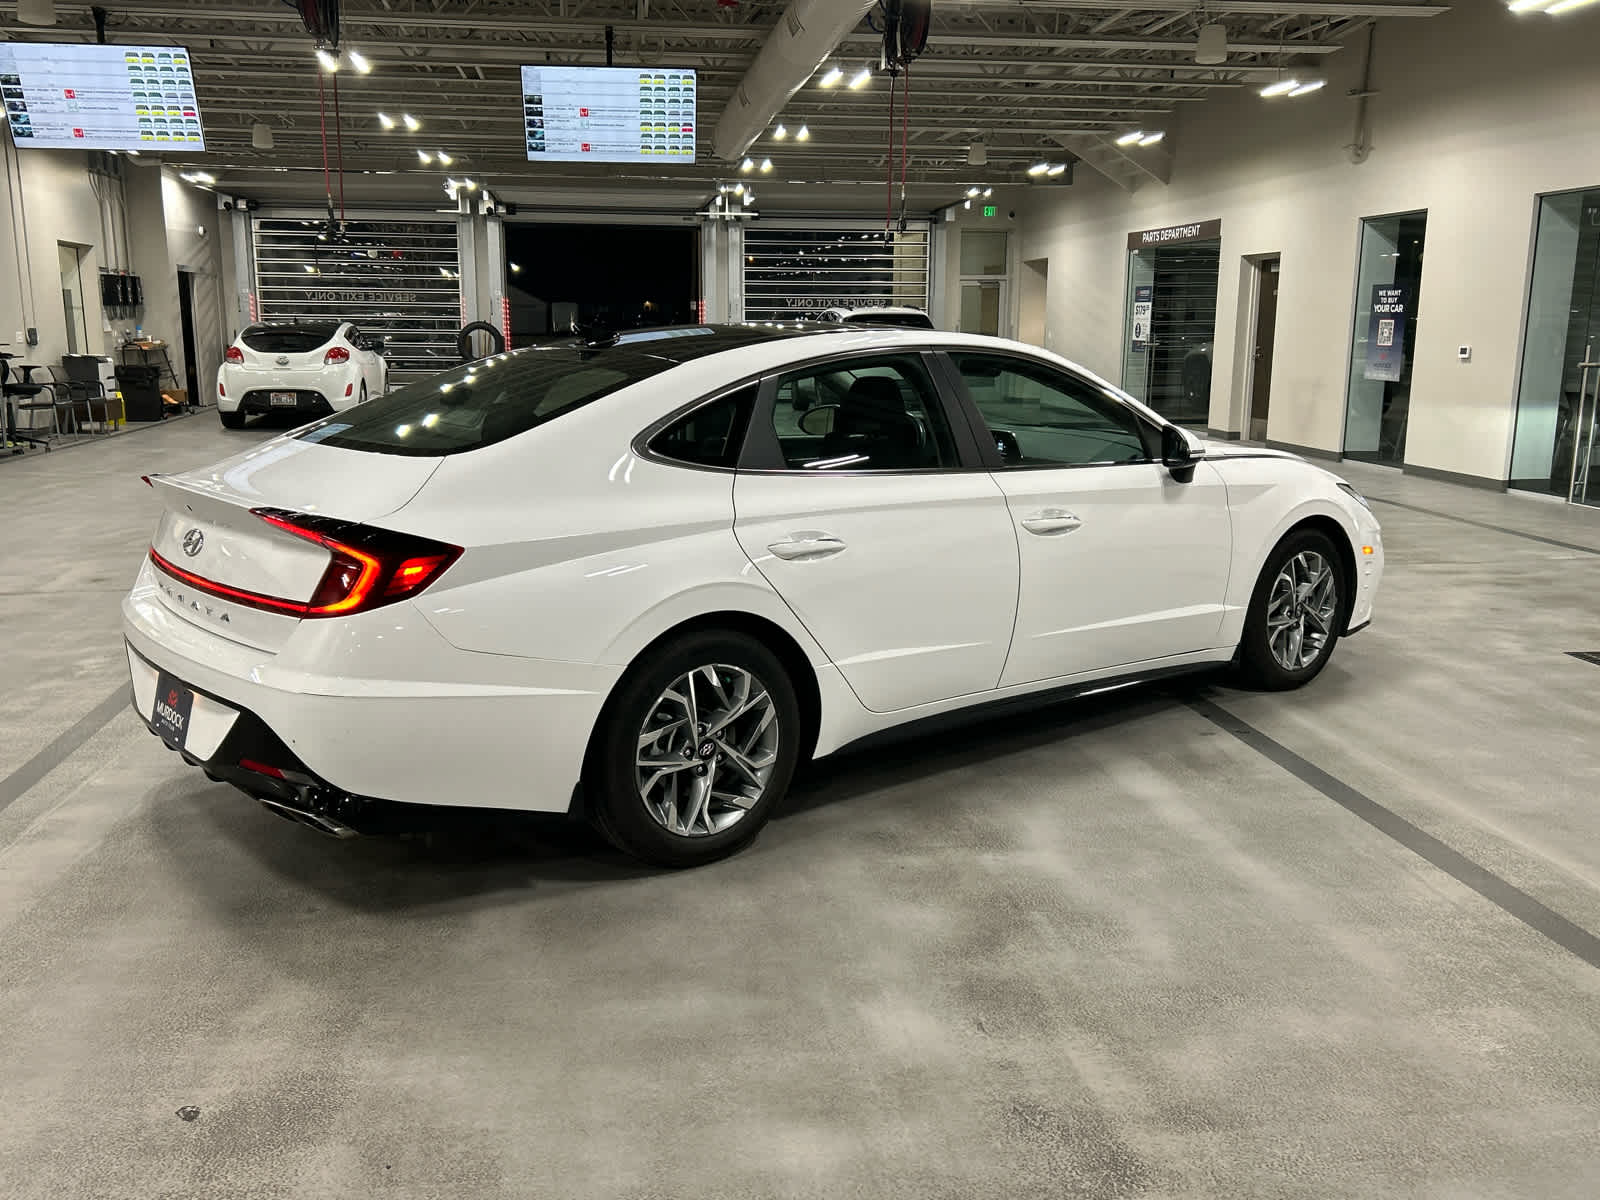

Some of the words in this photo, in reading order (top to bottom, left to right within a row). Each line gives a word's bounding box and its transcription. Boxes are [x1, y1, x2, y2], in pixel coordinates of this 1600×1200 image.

[984, 206, 997, 217] EXIT
[1142, 231, 1160, 243] PARTS
[1160, 224, 1201, 241] DEPARTMENT
[1387, 289, 1402, 297] WANT
[1373, 304, 1390, 313] YOUR
[1390, 304, 1404, 313] CAR
[156, 700, 185, 731] MURDOCK
